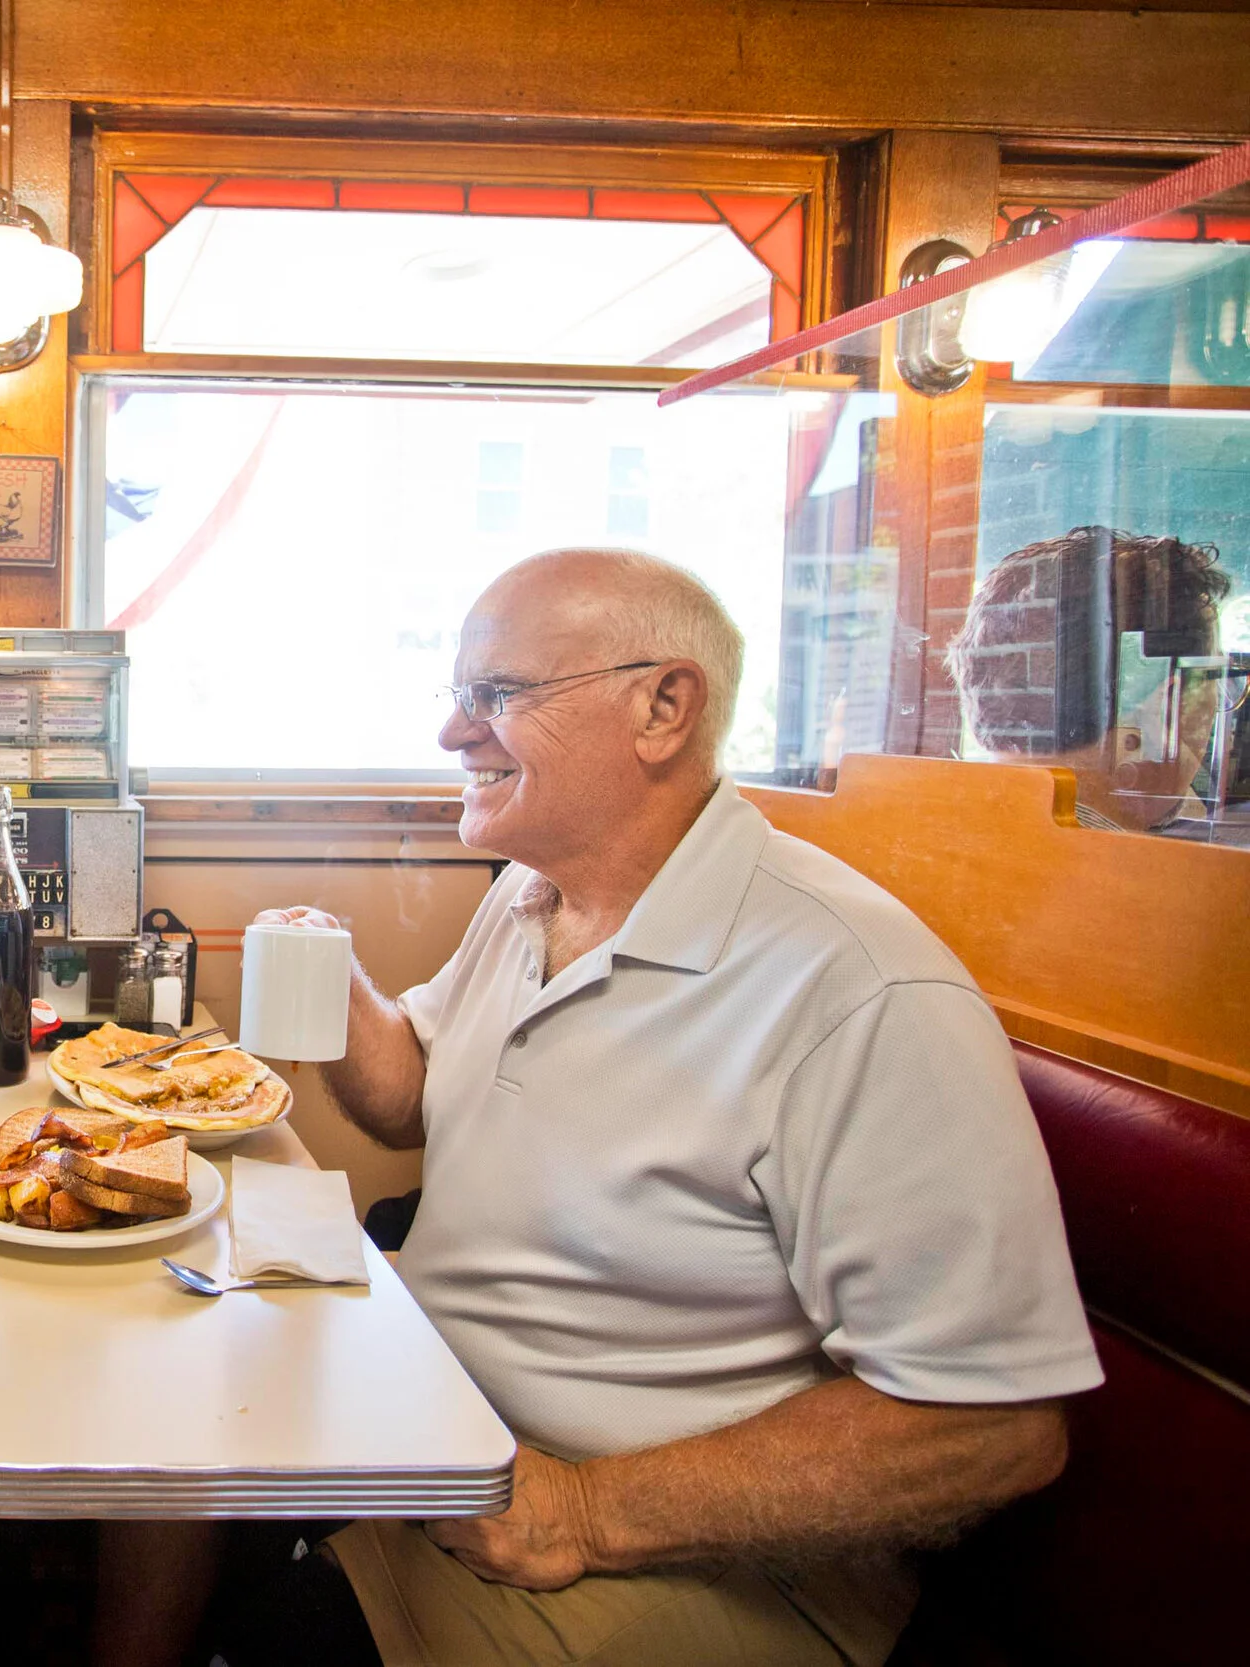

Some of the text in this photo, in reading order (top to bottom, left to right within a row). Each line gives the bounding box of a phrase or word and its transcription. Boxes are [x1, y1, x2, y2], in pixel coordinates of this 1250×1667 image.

[28, 875, 37, 888] H
[42, 875, 50, 888] J
[56, 875, 64, 888] K
[42, 890, 50, 903] U
[56, 890, 64, 903] V
[42, 916, 50, 929] 8
